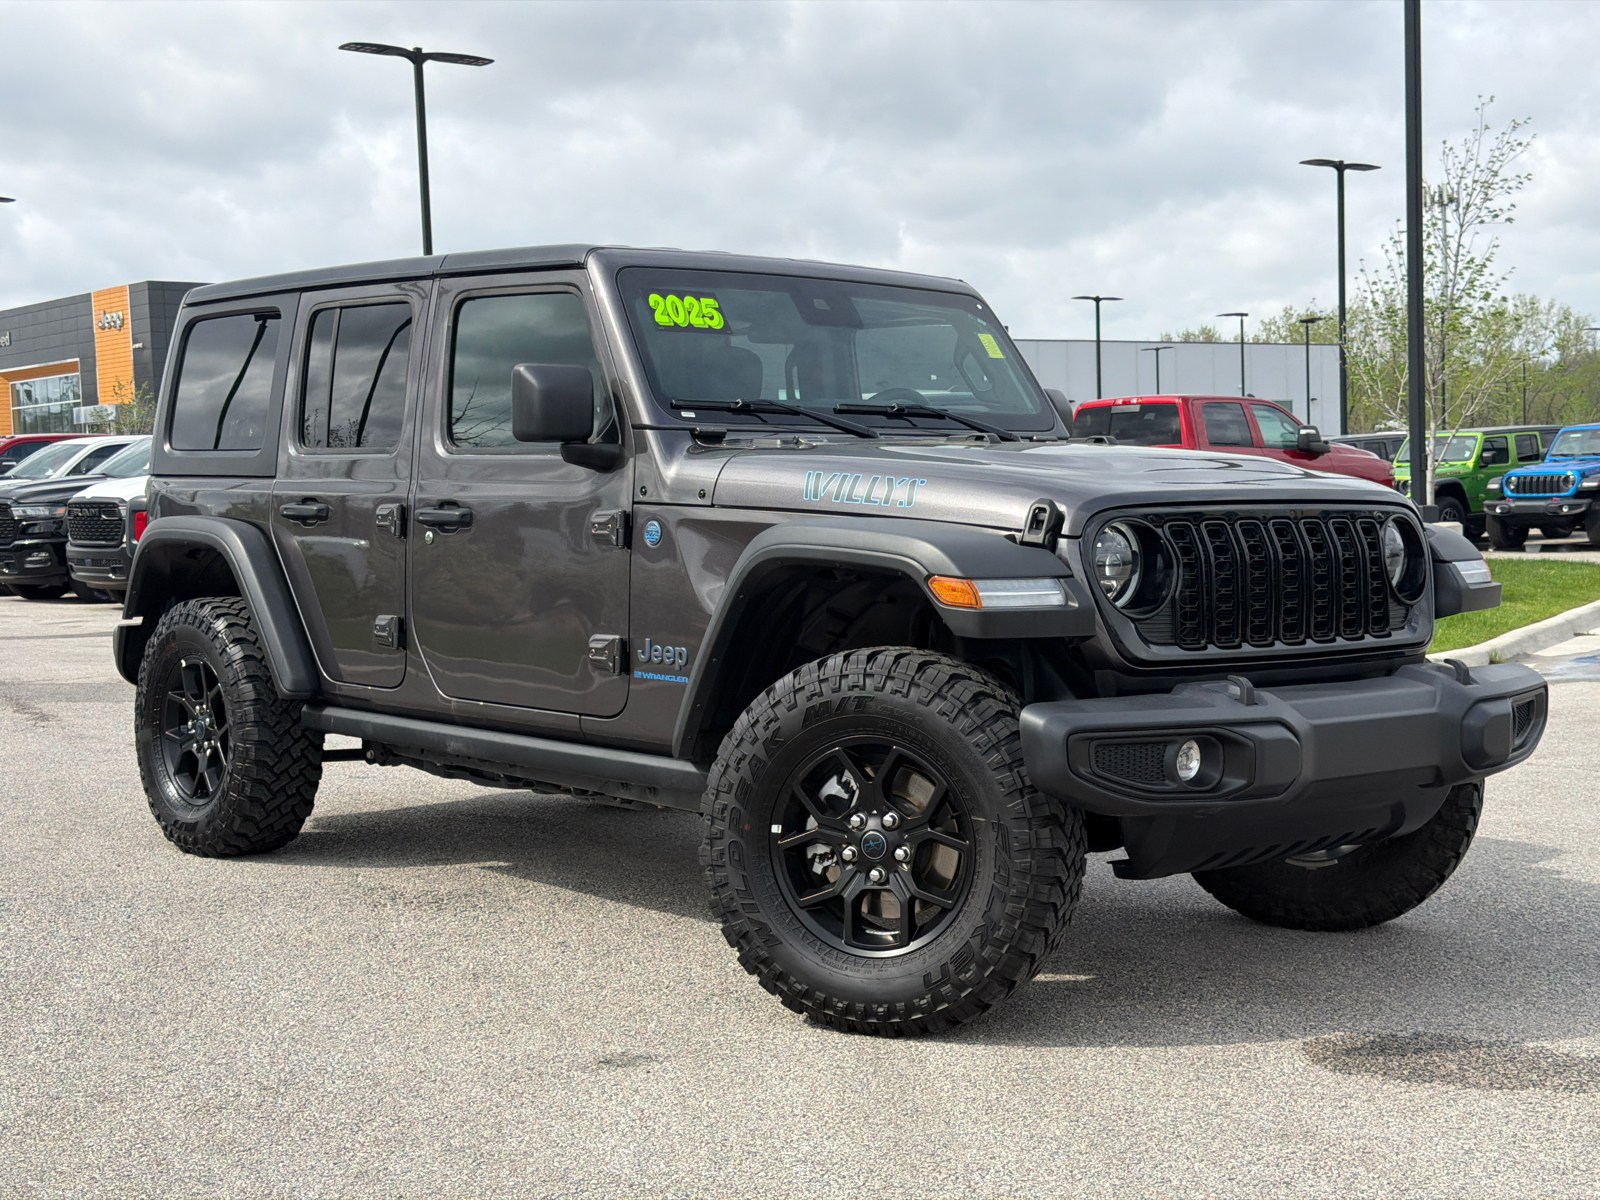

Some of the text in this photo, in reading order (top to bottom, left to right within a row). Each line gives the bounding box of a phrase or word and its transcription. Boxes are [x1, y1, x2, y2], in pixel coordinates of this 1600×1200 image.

[98, 309, 124, 332] Jeep
[648, 293, 724, 330] 2025
[803, 470, 928, 508] WILLYS
[73, 508, 100, 517] RAM
[637, 637, 688, 671] Jeep
[642, 671, 689, 683] WRANGLER
[728, 725, 784, 947] WILDPEAK
[801, 693, 875, 728] M/T
[922, 812, 1011, 991] FALKEN
